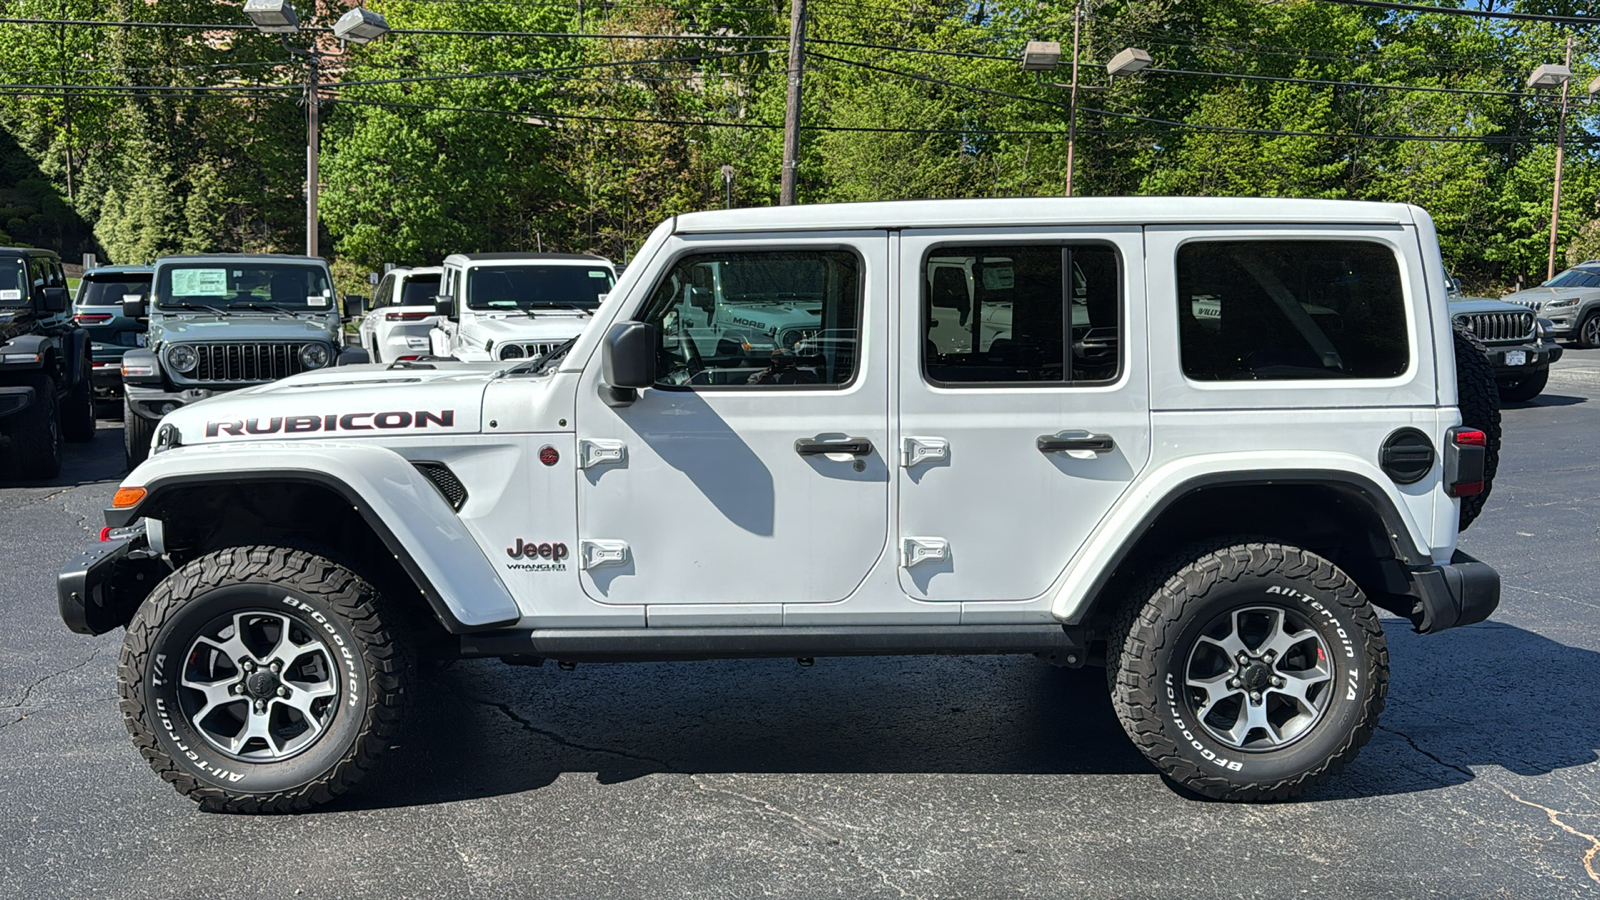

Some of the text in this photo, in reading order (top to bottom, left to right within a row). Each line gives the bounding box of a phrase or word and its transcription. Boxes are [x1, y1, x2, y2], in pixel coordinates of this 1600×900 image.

[733, 317, 765, 329] MOAB
[205, 410, 454, 437] RUBICON
[506, 537, 568, 562] Jeep
[152, 653, 168, 687] T/A
[282, 595, 359, 708] BFGoodrich
[1265, 585, 1355, 659] All-Terrain
[1345, 668, 1359, 701] T/A
[155, 697, 246, 784] All-Terrain
[1165, 673, 1243, 772] BFGoodrich
